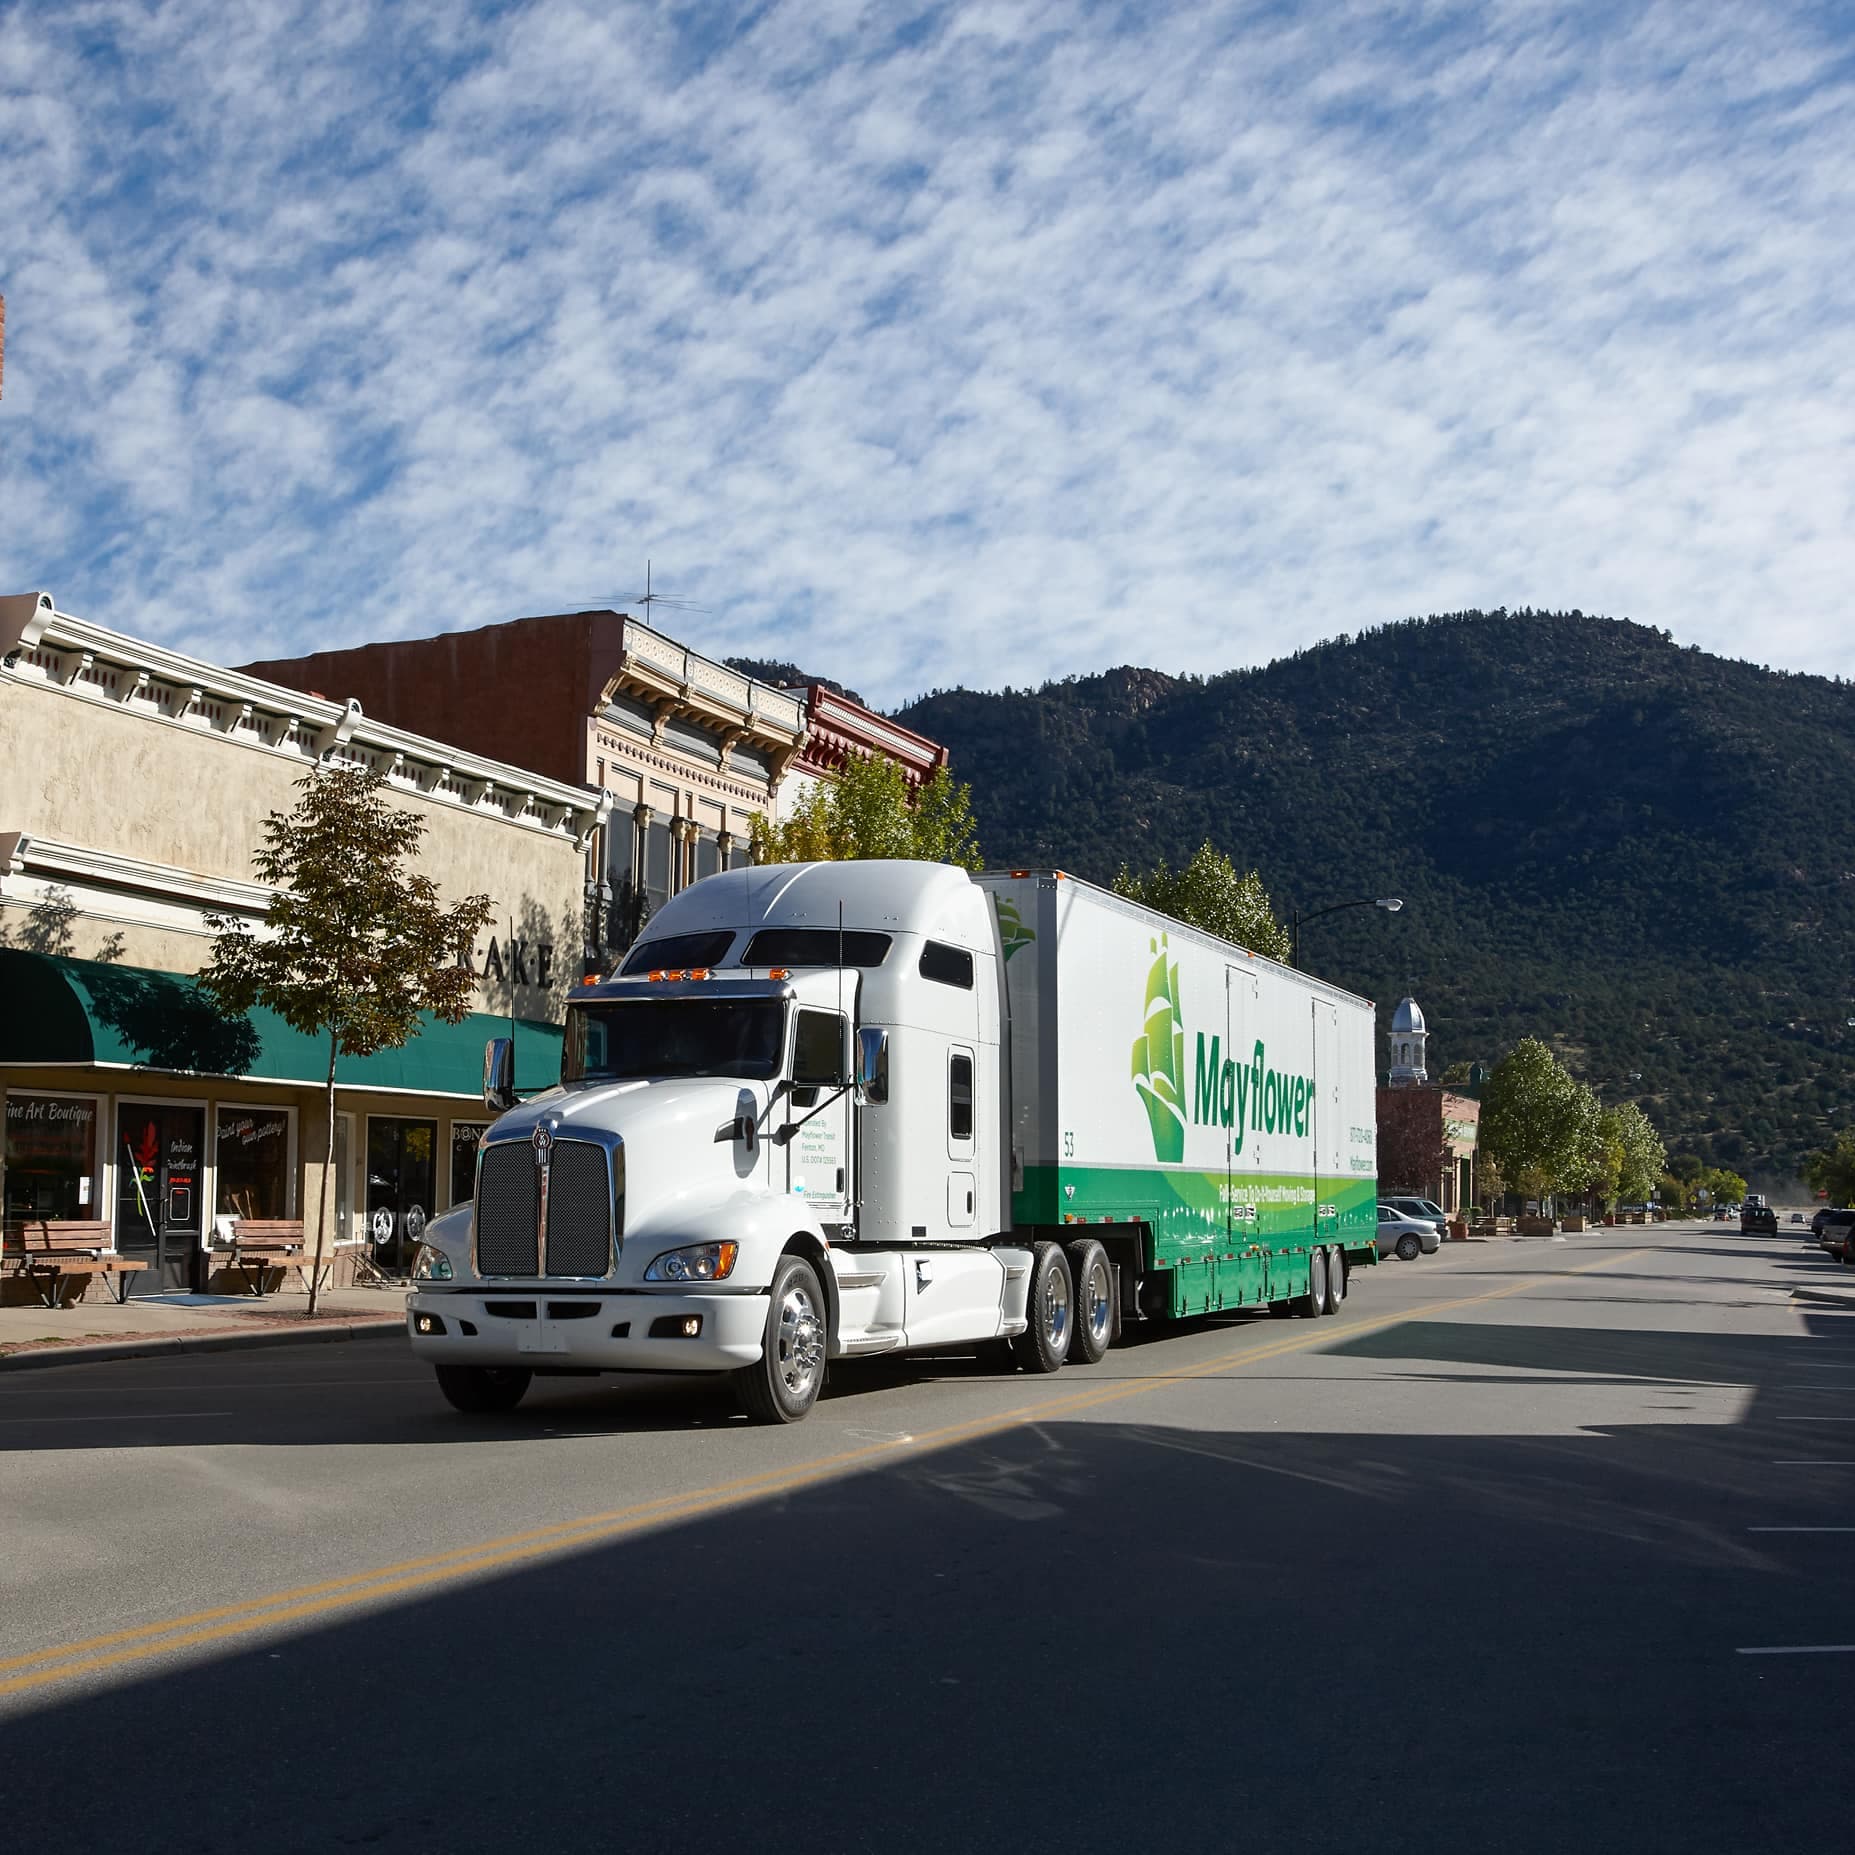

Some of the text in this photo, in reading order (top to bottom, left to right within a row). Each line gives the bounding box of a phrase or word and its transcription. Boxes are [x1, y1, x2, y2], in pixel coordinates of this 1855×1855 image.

[1194, 1031, 1315, 1156] Mayflower
[5, 1100, 94, 1127] ine Art Boutique
[1064, 1131, 1074, 1157] 53
